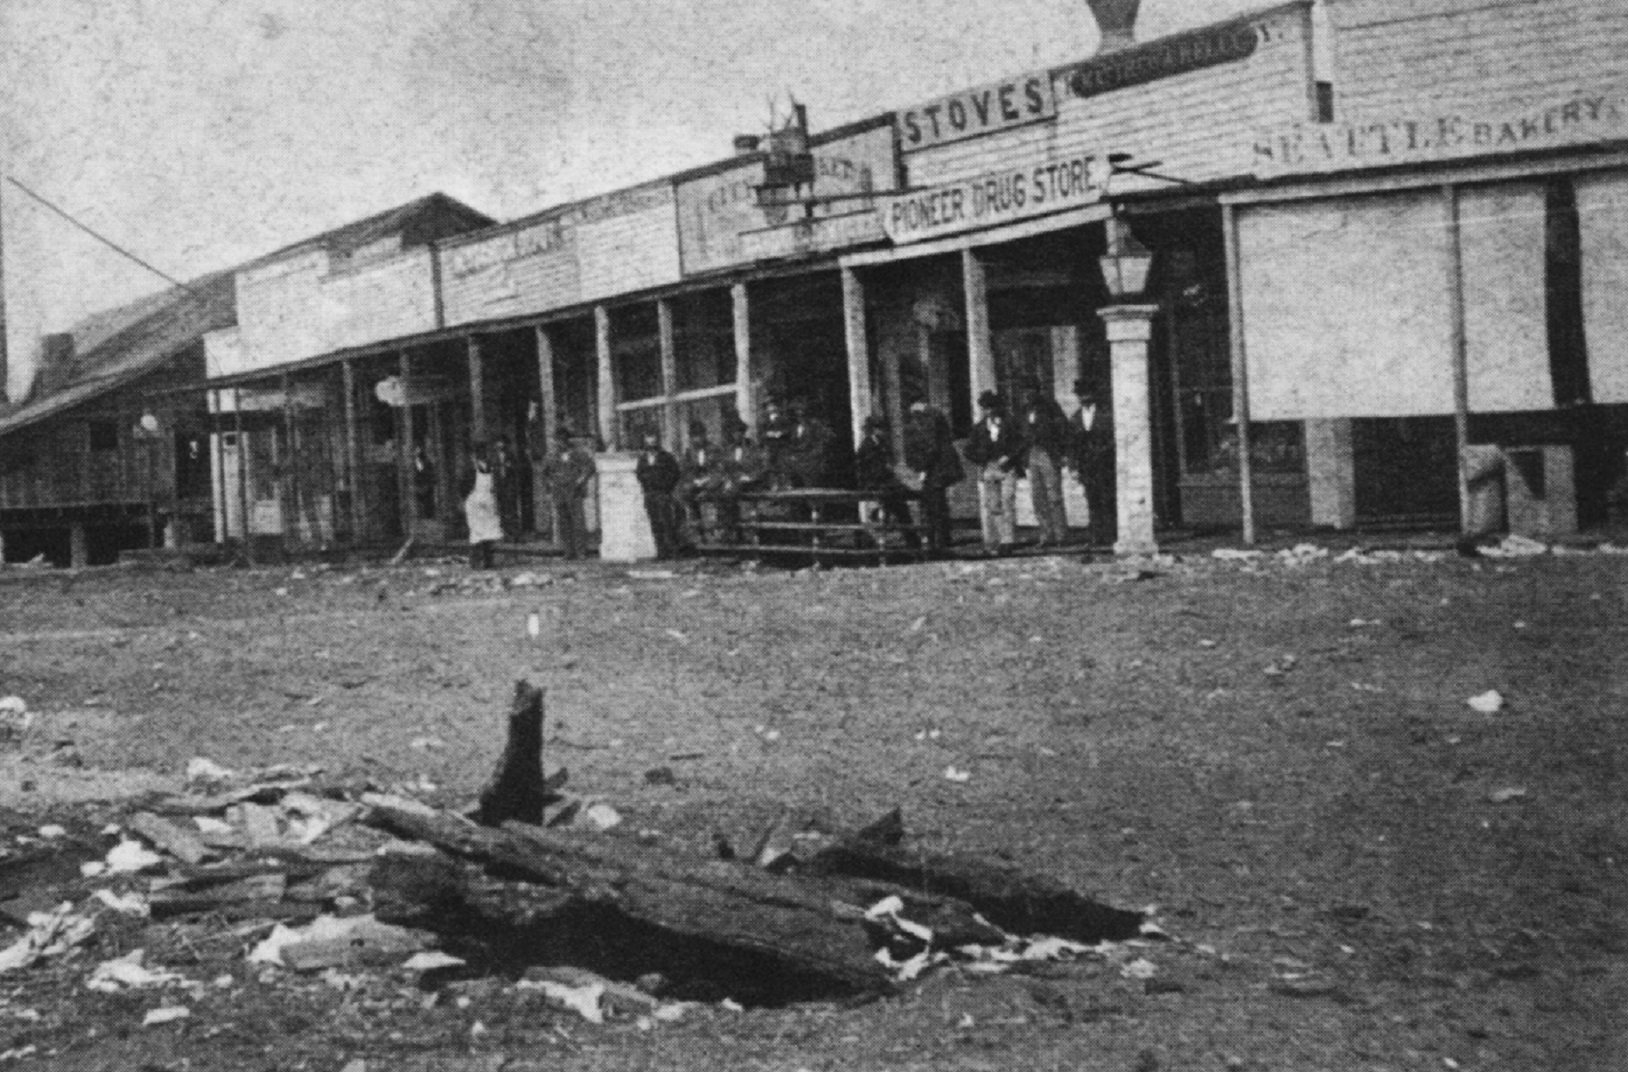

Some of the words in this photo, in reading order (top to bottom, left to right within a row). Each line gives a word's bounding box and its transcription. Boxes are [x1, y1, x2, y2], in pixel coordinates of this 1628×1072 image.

[905, 78, 1043, 143] STOVES
[1252, 117, 1464, 165] SEATTLE
[1473, 98, 1606, 145] BAKERY
[892, 189, 965, 232] PIONEER
[973, 173, 1025, 216] DRUG
